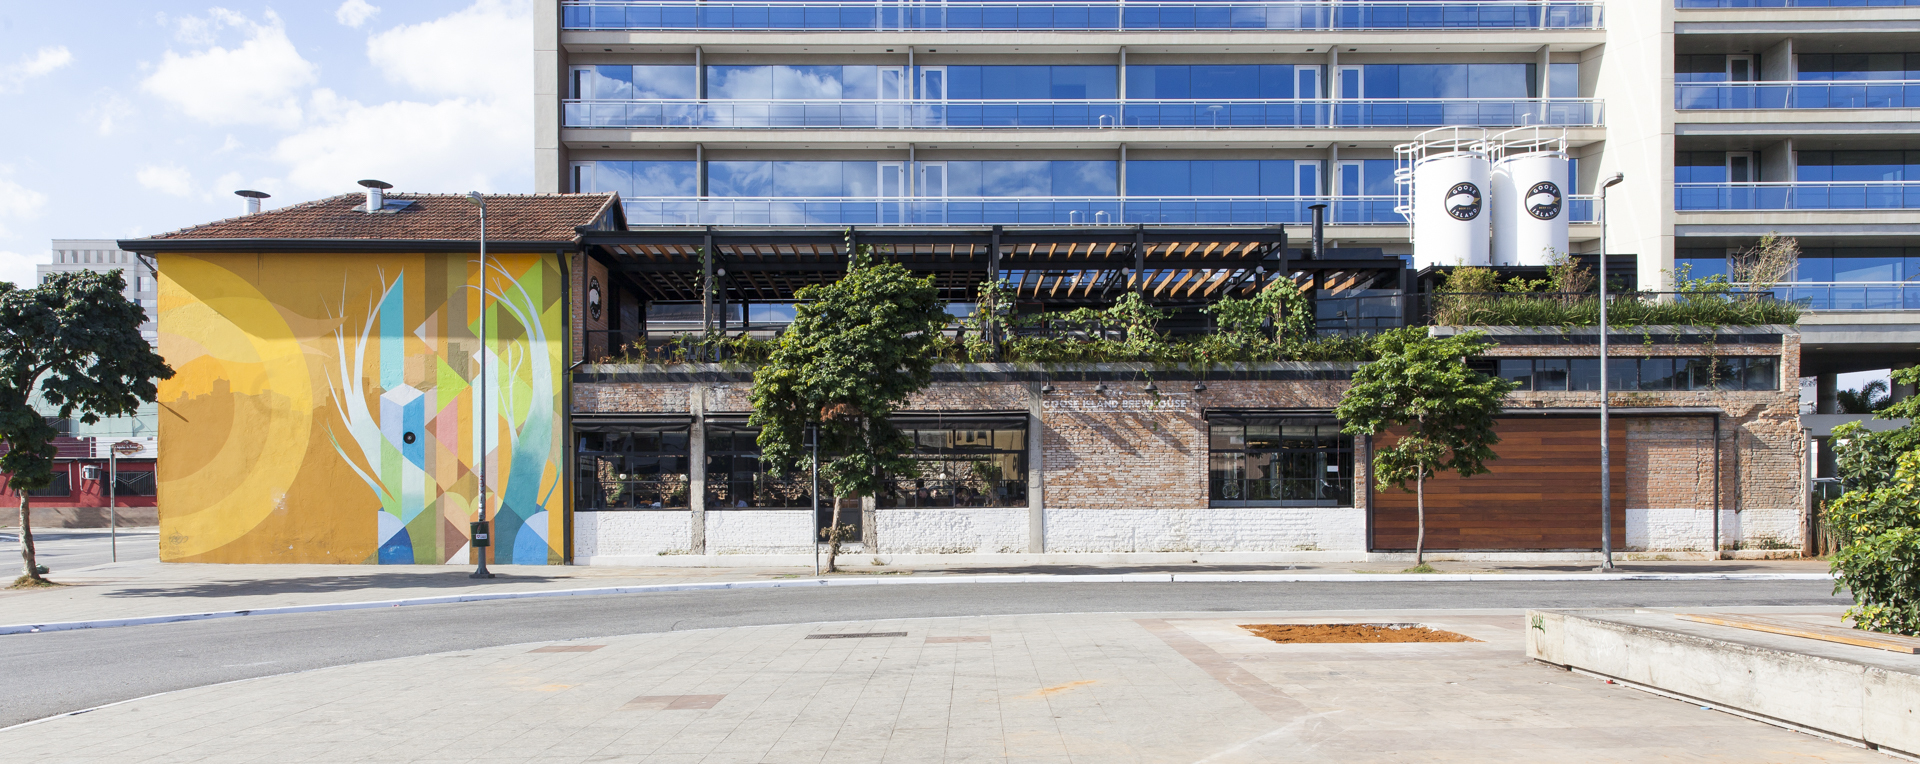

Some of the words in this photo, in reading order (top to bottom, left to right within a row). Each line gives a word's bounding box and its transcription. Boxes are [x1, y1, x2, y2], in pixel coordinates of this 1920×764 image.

[1452, 185, 1477, 194] GOOSE
[1532, 184, 1556, 194] GOOSE
[1452, 208, 1477, 218] ISLAND
[1532, 207, 1558, 217] ISLAND
[1042, 400, 1079, 409] GOOSE
[1082, 400, 1119, 409] ISLAND
